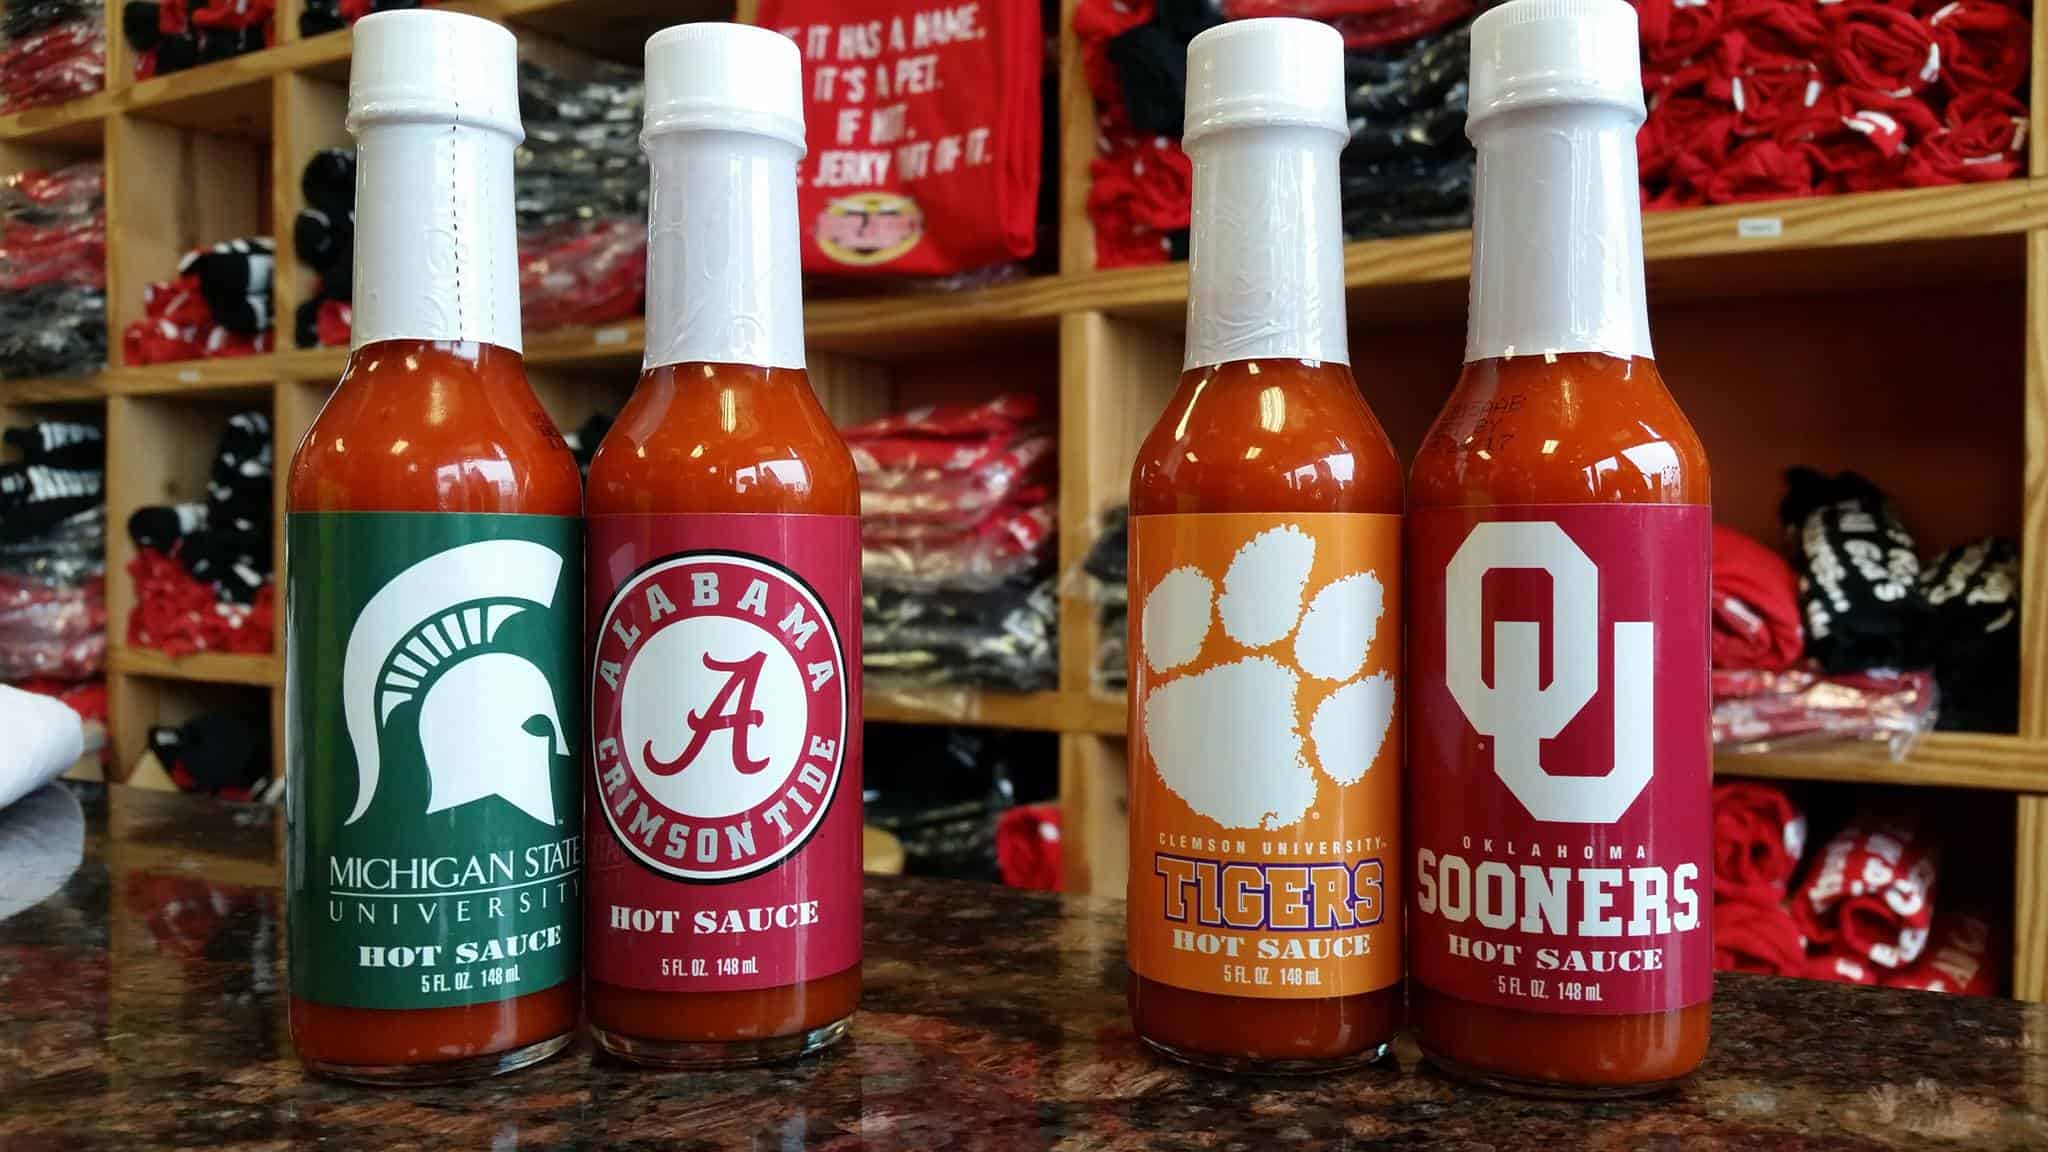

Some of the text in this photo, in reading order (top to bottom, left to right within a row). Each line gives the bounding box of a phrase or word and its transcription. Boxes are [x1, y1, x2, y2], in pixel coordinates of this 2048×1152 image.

[806, 24, 832, 60] IT
[890, 16, 906, 50] A
[813, 151, 892, 188] JERKY
[600, 572, 834, 692] ALABAMA
[643, 651, 770, 776] A
[599, 735, 836, 864] CRIMSON TIDE
[330, 850, 514, 890] MICHIGAN
[525, 835, 580, 878] STATE
[1159, 832, 1381, 856] CLEMSON UNIVERSITY
[1462, 835, 1646, 859] OKLAHOMA
[1155, 852, 1384, 931] TIGERS
[1417, 847, 1698, 937] SOONERS
[611, 900, 819, 935] HOT SAUCE
[359, 925, 561, 968] HOT SAUCE
[1171, 928, 1371, 960] HOT SAUCE
[1448, 934, 1663, 972] HOT SAUCE
[421, 964, 520, 993] 5 FL. OZ. 148 mL
[661, 955, 759, 977] 5 FL. OZ. 148 mL
[1223, 964, 1232, 983] 5
[1235, 965, 1251, 984] FL.
[1255, 966, 1272, 985] OZ.
[1280, 966, 1301, 985] 148
[1498, 975, 1603, 1001] 5 FL. OZ. 148 mL
